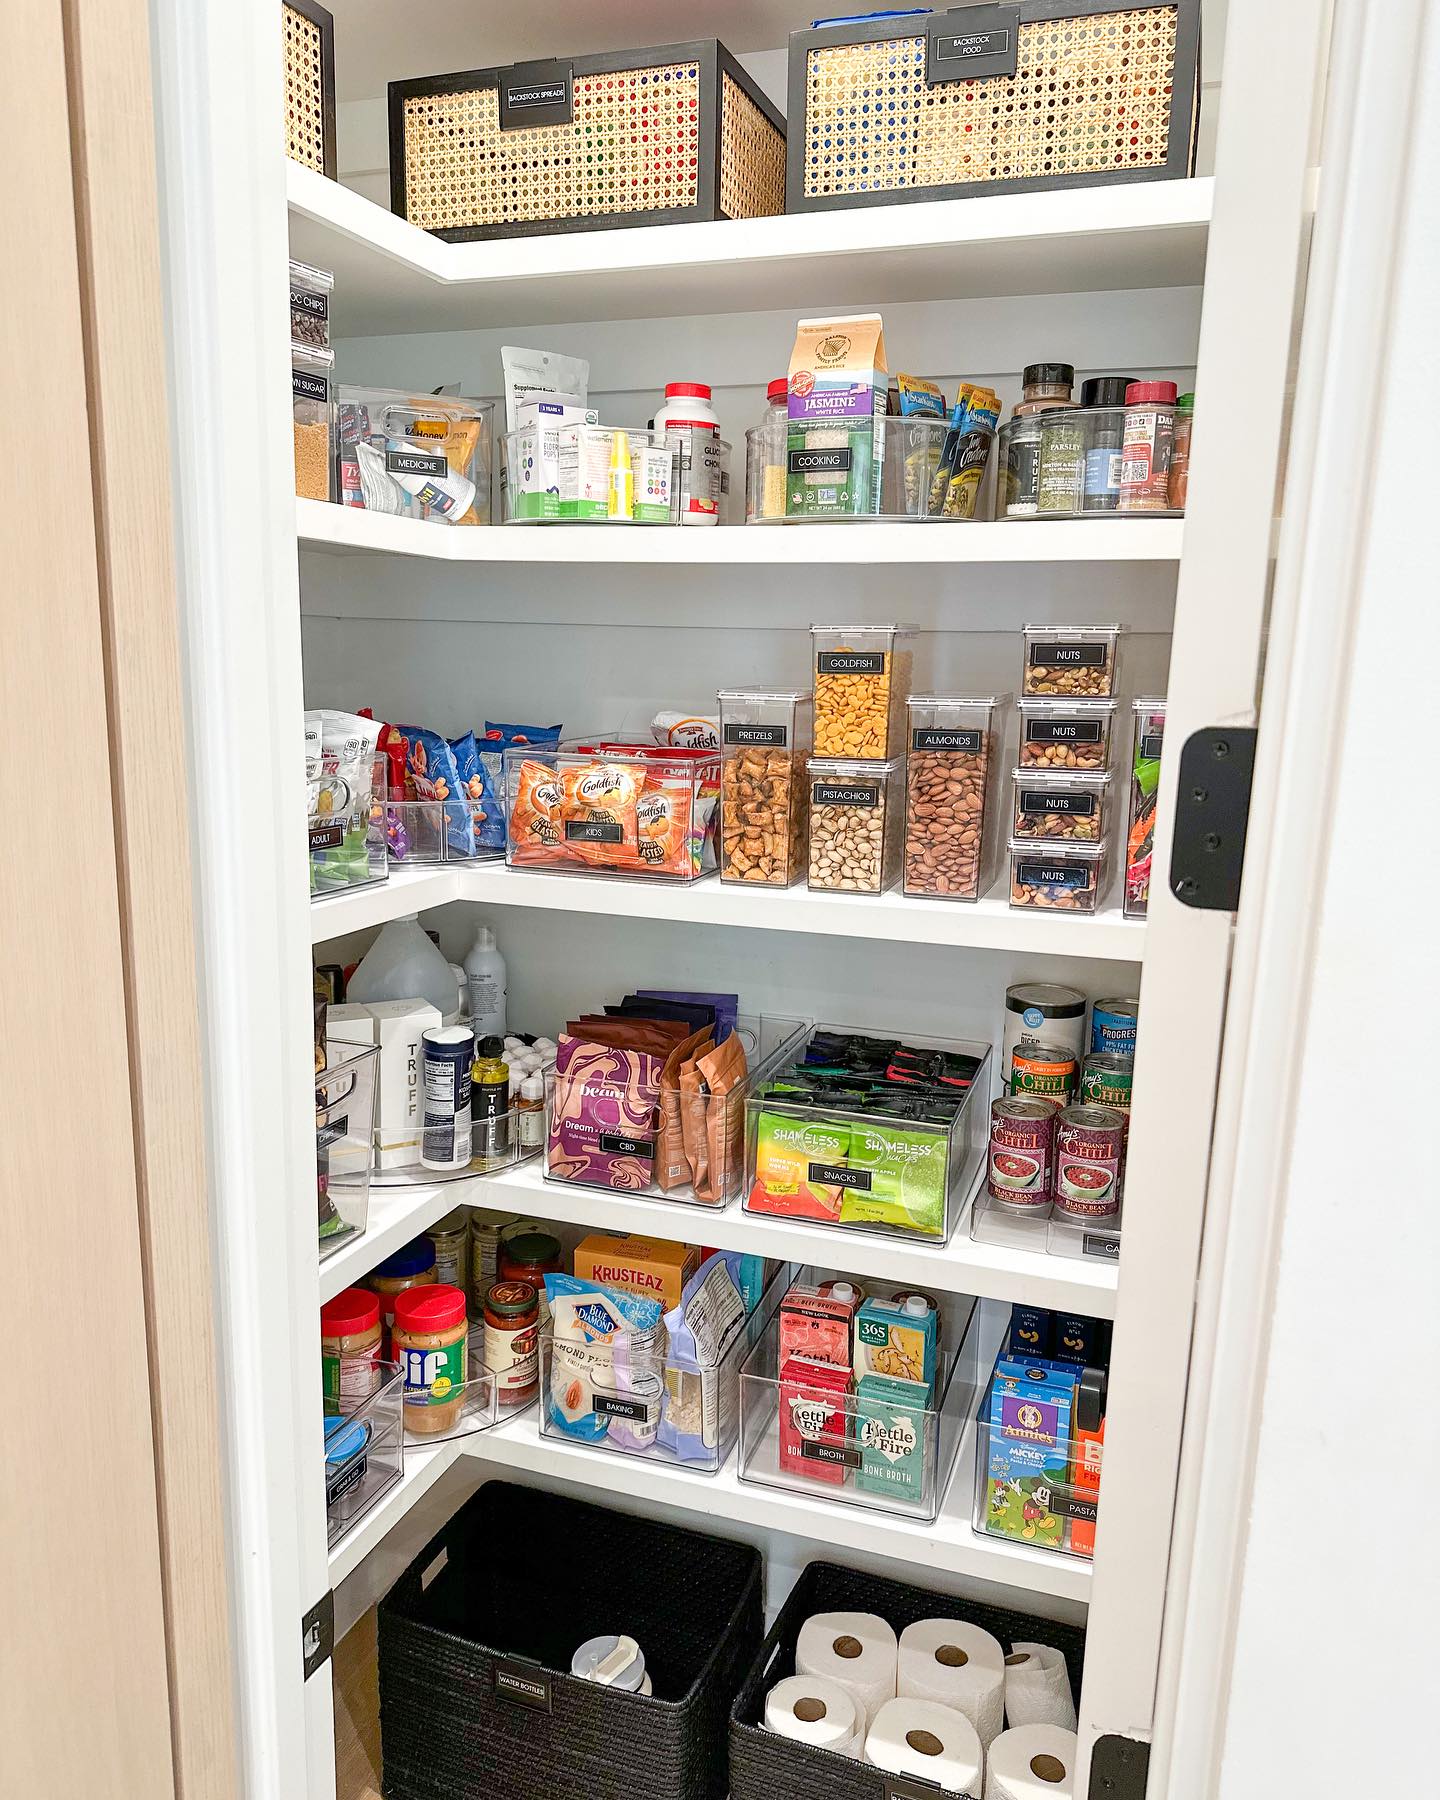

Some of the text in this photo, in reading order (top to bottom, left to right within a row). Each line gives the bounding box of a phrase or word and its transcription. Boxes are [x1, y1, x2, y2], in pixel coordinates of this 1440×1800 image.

[953, 35, 990, 47] BACKSTOCK
[962, 46, 982, 54] FOOD
[509, 89, 564, 102] BACKSTOCK SPREADS
[303, 296, 324, 312] CHIPS
[302, 380, 325, 394] SUGAR
[804, 397, 856, 412] JASMINE
[1050, 443, 1080, 451] PARSLEY
[397, 458, 437, 471] MEDICINE
[798, 455, 841, 467] COOKING
[1031, 449, 1040, 494] TRUFF
[1056, 650, 1081, 661] NUTS
[830, 658, 873, 669] GOLDFISH
[738, 730, 773, 741] PRETZELS
[1052, 725, 1076, 737] NUTS
[925, 735, 971, 746] ALMONDS
[582, 777, 621, 794] Goldfish
[822, 790, 871, 801] PISTACHIOS
[1045, 797, 1069, 809] NUTS
[311, 833, 331, 845] ADULT
[585, 828, 602, 837] KIDS
[1041, 870, 1065, 881] NUTS
[1012, 1060, 1032, 1077] Amy's
[407, 1043, 417, 1117] TRUFF
[1021, 1073, 1065, 1091] CHILI
[1082, 1070, 1103, 1088] Amy's
[580, 1083, 625, 1099] beam
[488, 1094, 497, 1147] TRUFF
[565, 1120, 594, 1133] Dream
[773, 1128, 840, 1148] SHAMELESS
[994, 1128, 1039, 1149] CHILI
[1002, 1129, 1031, 1139] ORGANIC
[1057, 1125, 1080, 1143] Amy's
[619, 1142, 636, 1151] CBD
[1065, 1139, 1114, 1159] CHILI
[1079, 1141, 1106, 1150] ORGANIC
[823, 1170, 857, 1183] SNACKS
[994, 1186, 1033, 1200] BLACK BEAN
[1065, 1199, 1107, 1212] BLACK BEAN
[592, 1264, 664, 1292] KRUSTEAZ
[590, 1304, 608, 1321] BLUE
[578, 1308, 615, 1334] DIAMOND
[577, 1321, 610, 1343] ALMONDS
[861, 1322, 886, 1338] 365
[396, 1349, 448, 1385] Jif
[606, 1402, 634, 1415] BAKING
[865, 1422, 913, 1444] Kettle
[1004, 1424, 1053, 1444] Annie's
[819, 1448, 845, 1461] BROTH
[880, 1439, 912, 1456] Fire
[1008, 1447, 1047, 1462] MICKEY
[351, 1468, 359, 1479] GO
[864, 1464, 912, 1484] BONE BROTH
[1069, 1503, 1097, 1517] PASTA
[499, 1676, 544, 1696] WATER BOTTLES
